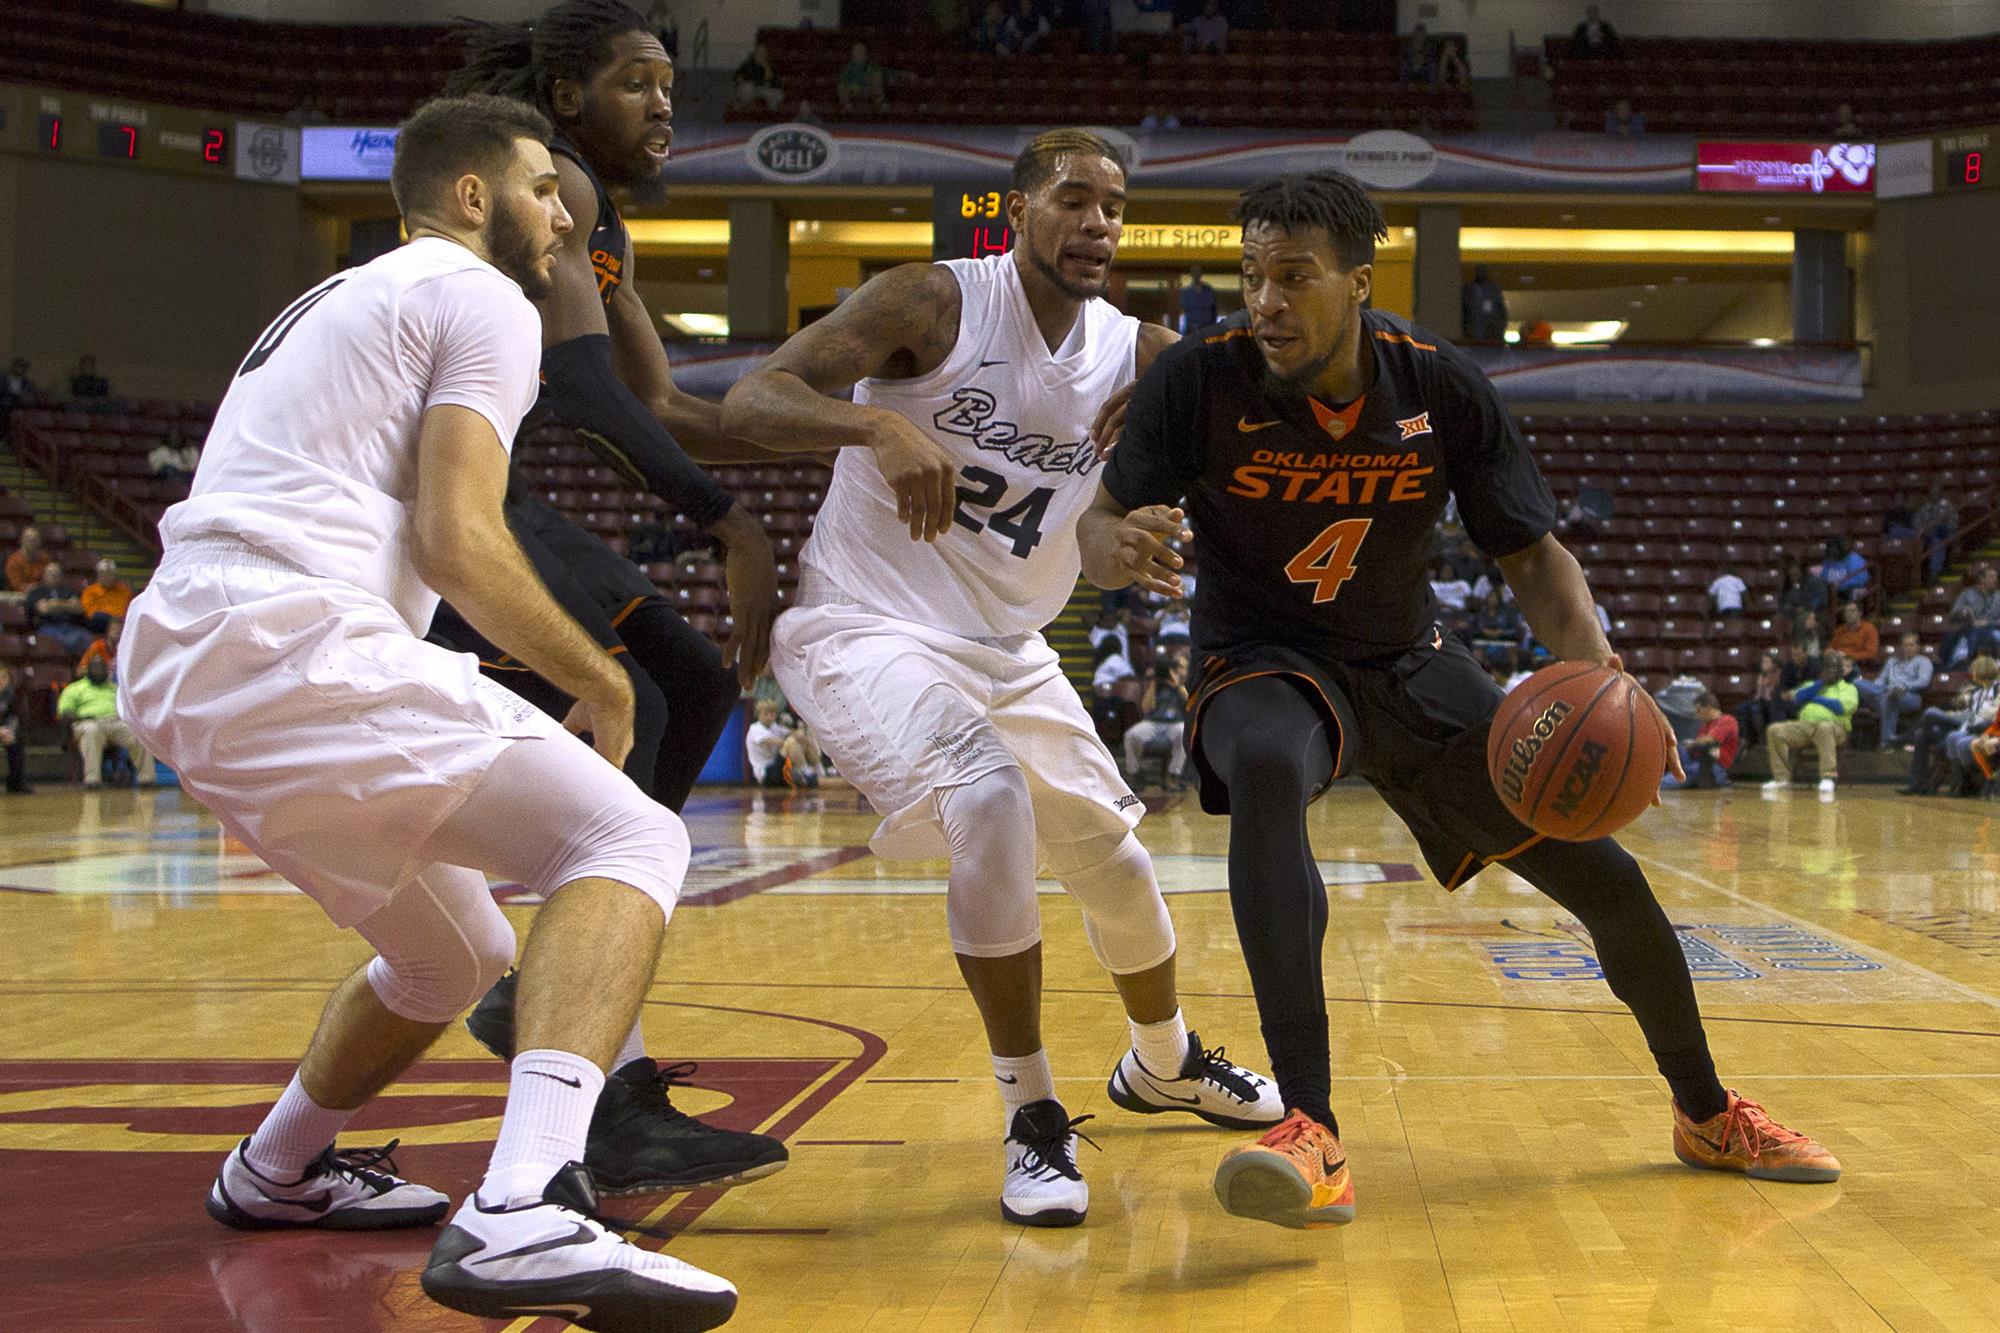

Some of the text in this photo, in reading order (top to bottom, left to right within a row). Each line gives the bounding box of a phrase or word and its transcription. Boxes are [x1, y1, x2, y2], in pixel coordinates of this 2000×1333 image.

[51, 119, 59, 149] 1
[119, 126, 136, 159] 7
[204, 130, 224, 162] 2
[771, 149, 813, 169] DELI
[1965, 152, 1981, 184] 8
[972, 227, 1009, 259] 14
[1120, 229, 1230, 246] IRIT SHOP
[933, 388, 1102, 476] Beach
[1252, 450, 1419, 469] OKLAHOMA
[1226, 466, 1434, 504] STATE
[954, 465, 1057, 560] 24
[1284, 518, 1373, 604] 4
[1502, 700, 1574, 804] Wilson
[1550, 739, 1609, 818] NCAA
